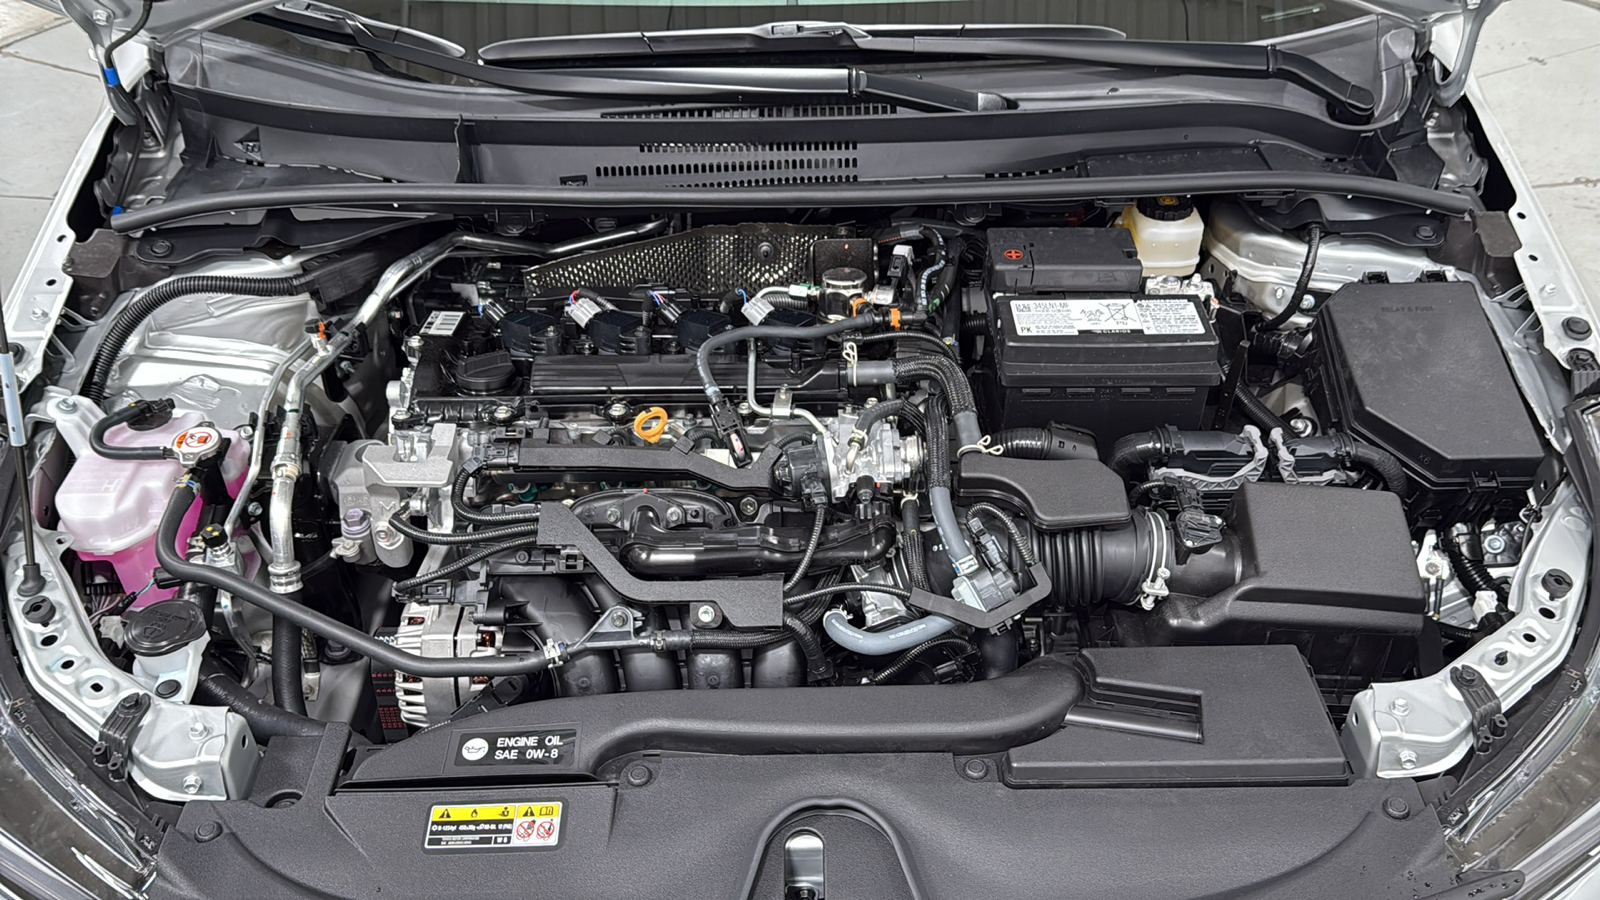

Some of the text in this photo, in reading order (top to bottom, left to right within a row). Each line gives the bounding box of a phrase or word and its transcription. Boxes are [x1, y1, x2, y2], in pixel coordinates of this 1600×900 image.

[496, 735, 564, 748] ENGINE OIL
[494, 748, 559, 760] SAE 0W-8
